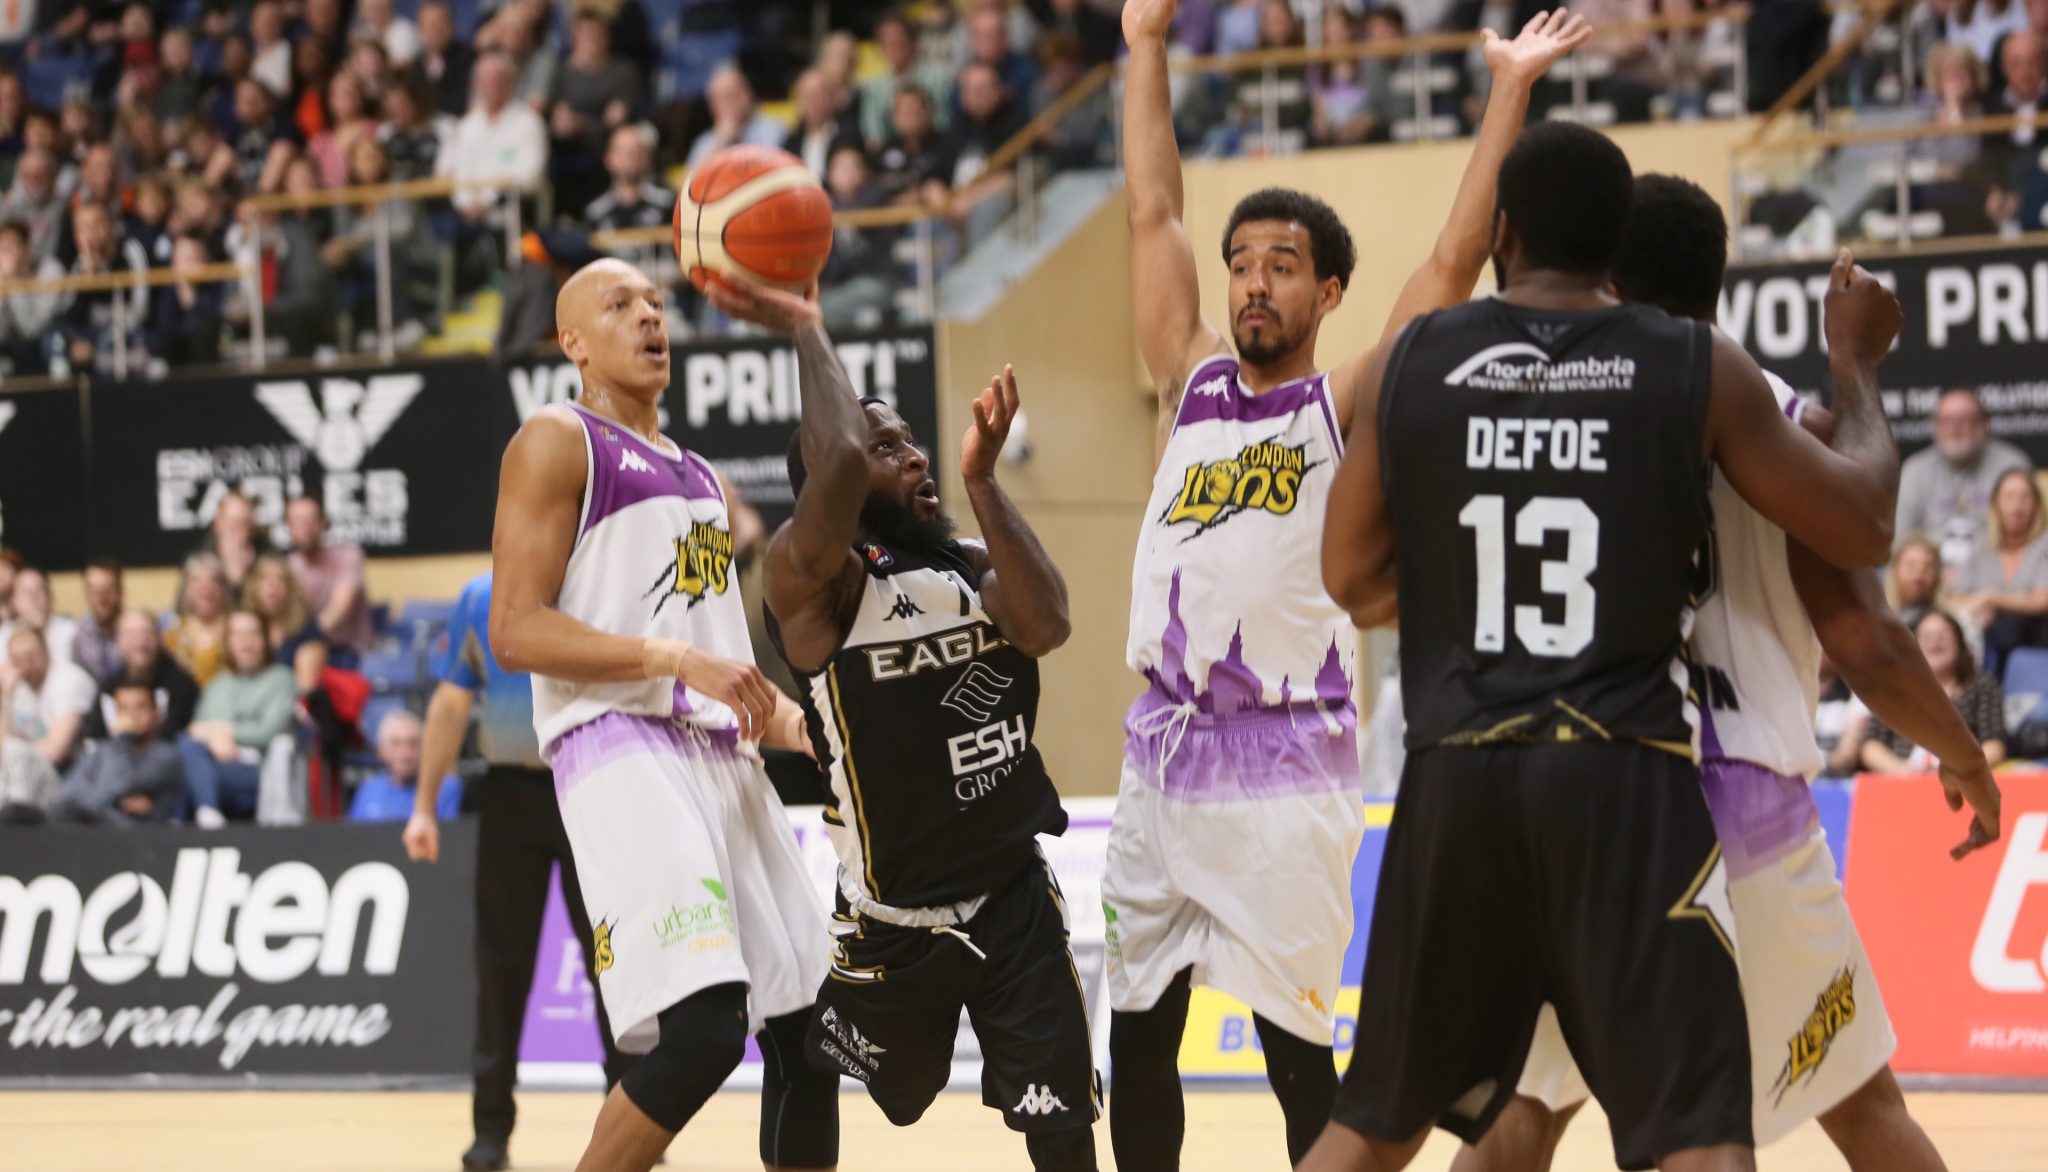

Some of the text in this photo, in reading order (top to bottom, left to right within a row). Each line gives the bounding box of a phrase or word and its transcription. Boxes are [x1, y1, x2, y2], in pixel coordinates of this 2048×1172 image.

[1717, 270, 1900, 359] VO
[685, 341, 897, 429] PRIT!
[1486, 355, 1635, 380] northumbria
[1548, 376, 1632, 393] NEWCASTLE
[1241, 444, 1302, 471] LONDON
[1466, 416, 1609, 472] DEFOE
[1459, 494, 1600, 657] 13
[863, 626, 1012, 682] EAGL
[947, 714, 1026, 776] ESH
[0, 847, 409, 984] molten
[9, 982, 391, 1070] the real game
